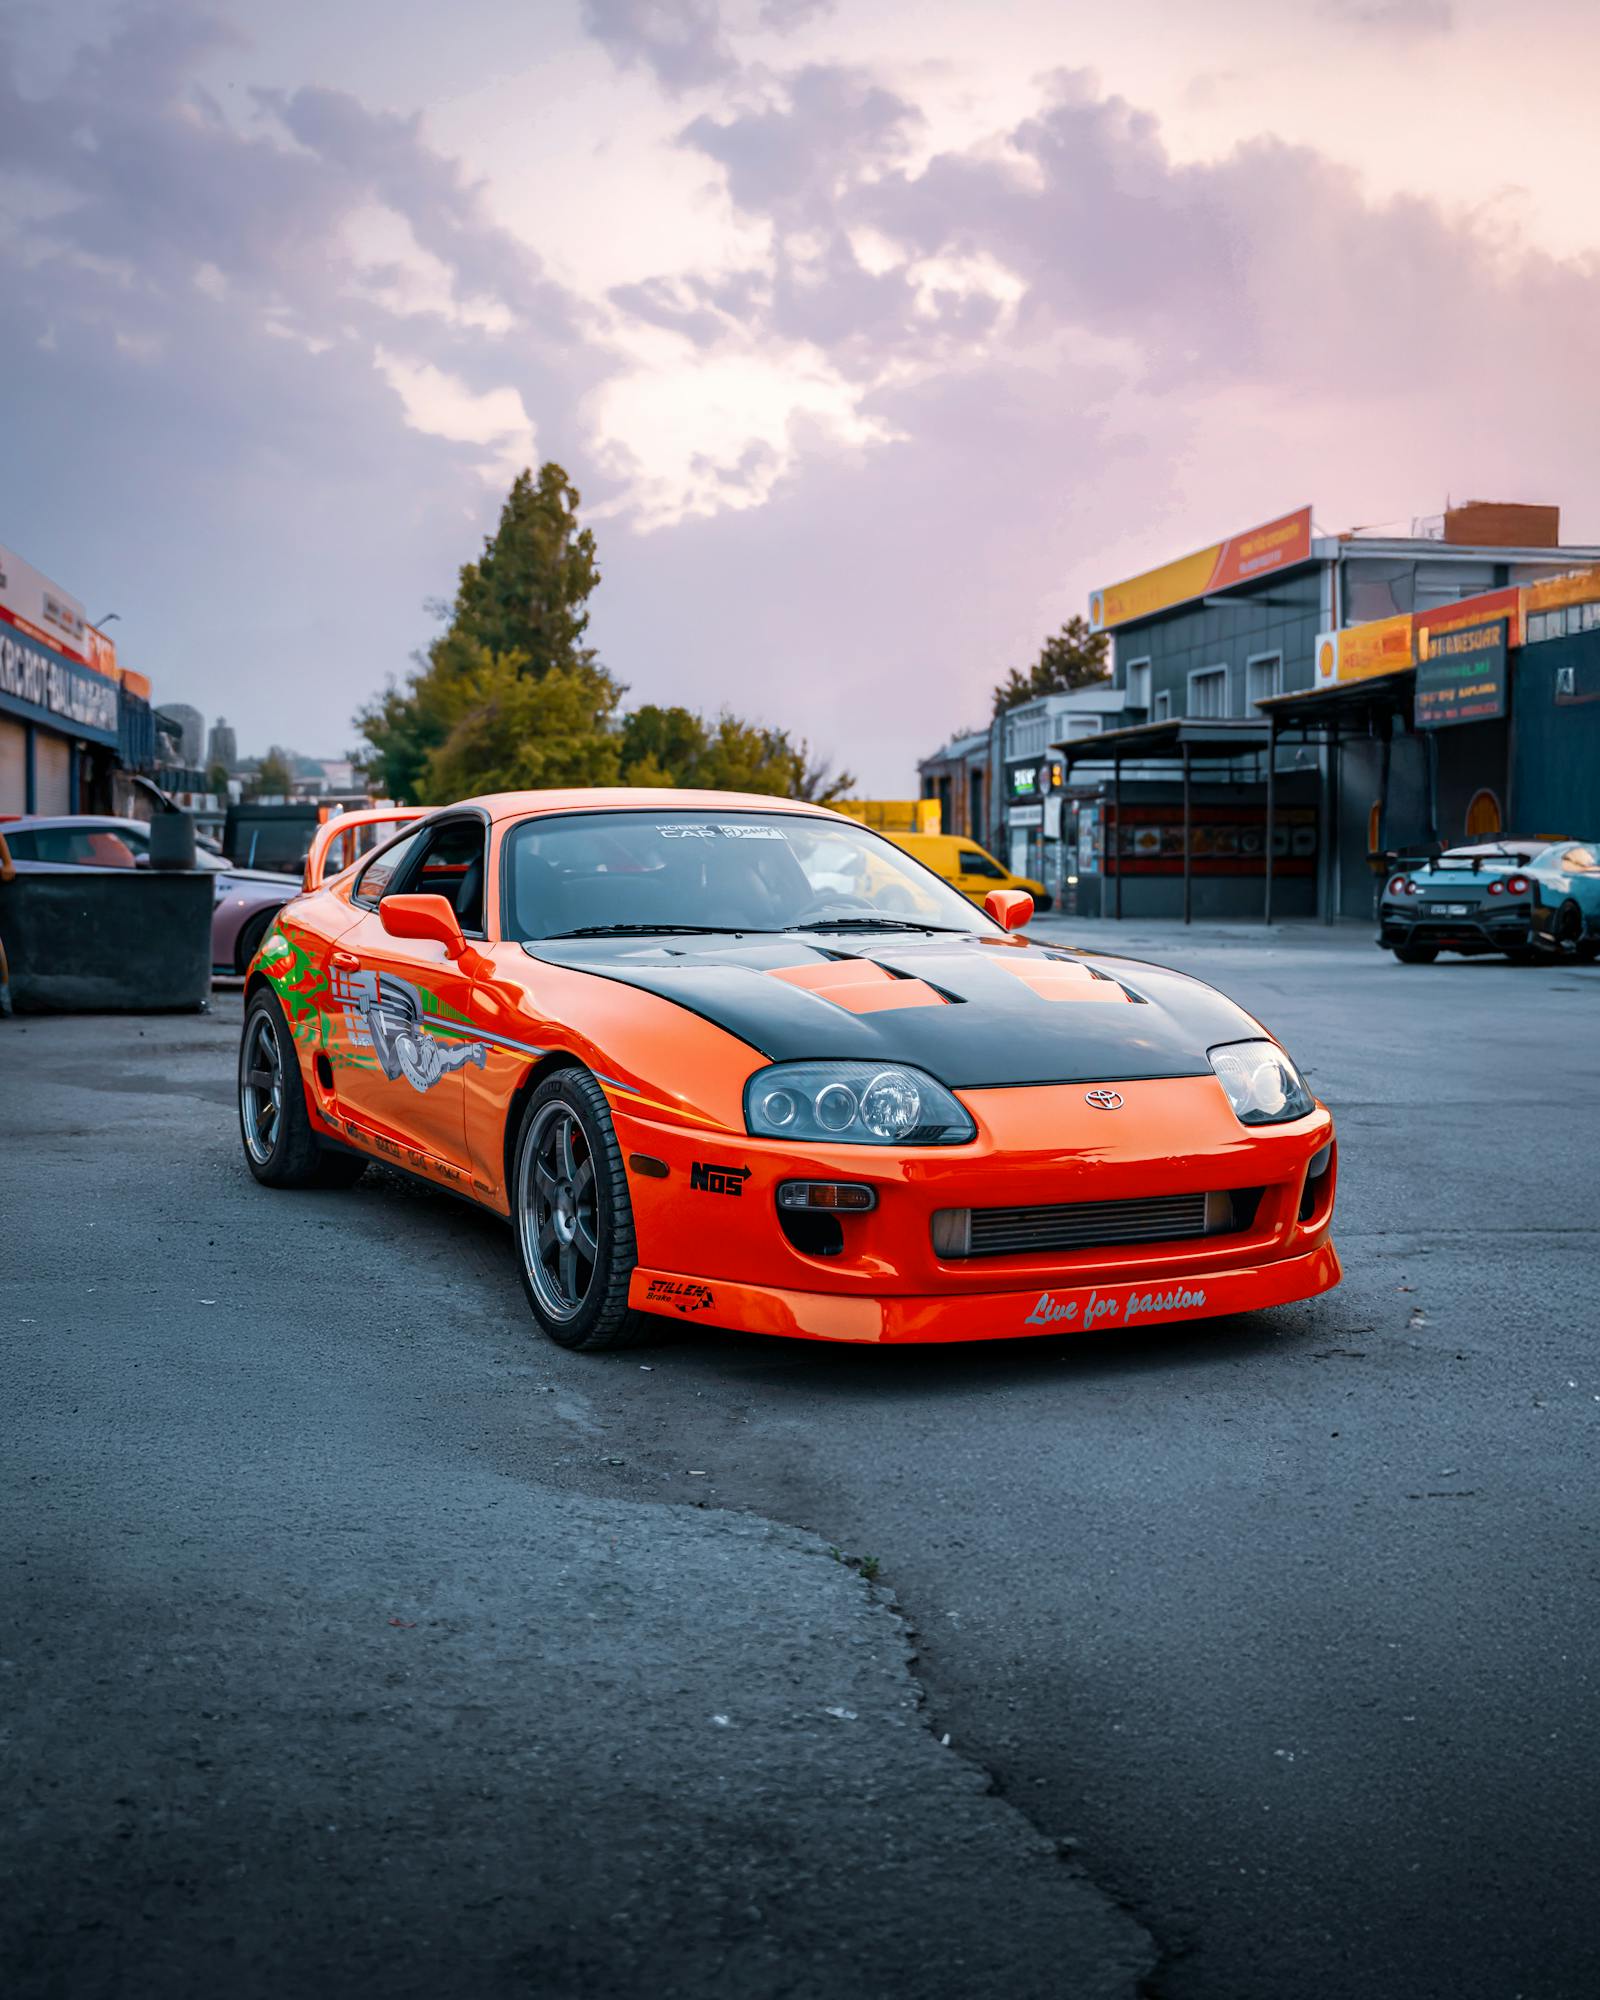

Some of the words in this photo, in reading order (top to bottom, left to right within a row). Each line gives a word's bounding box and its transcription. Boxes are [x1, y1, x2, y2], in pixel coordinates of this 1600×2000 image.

[660, 830, 717, 838] CAR
[689, 1161, 752, 1197] NOS
[646, 1292, 672, 1303] Brake
[1024, 1292, 1078, 1325] Live
[1083, 1290, 1119, 1329] for
[1124, 1286, 1207, 1323] passion
